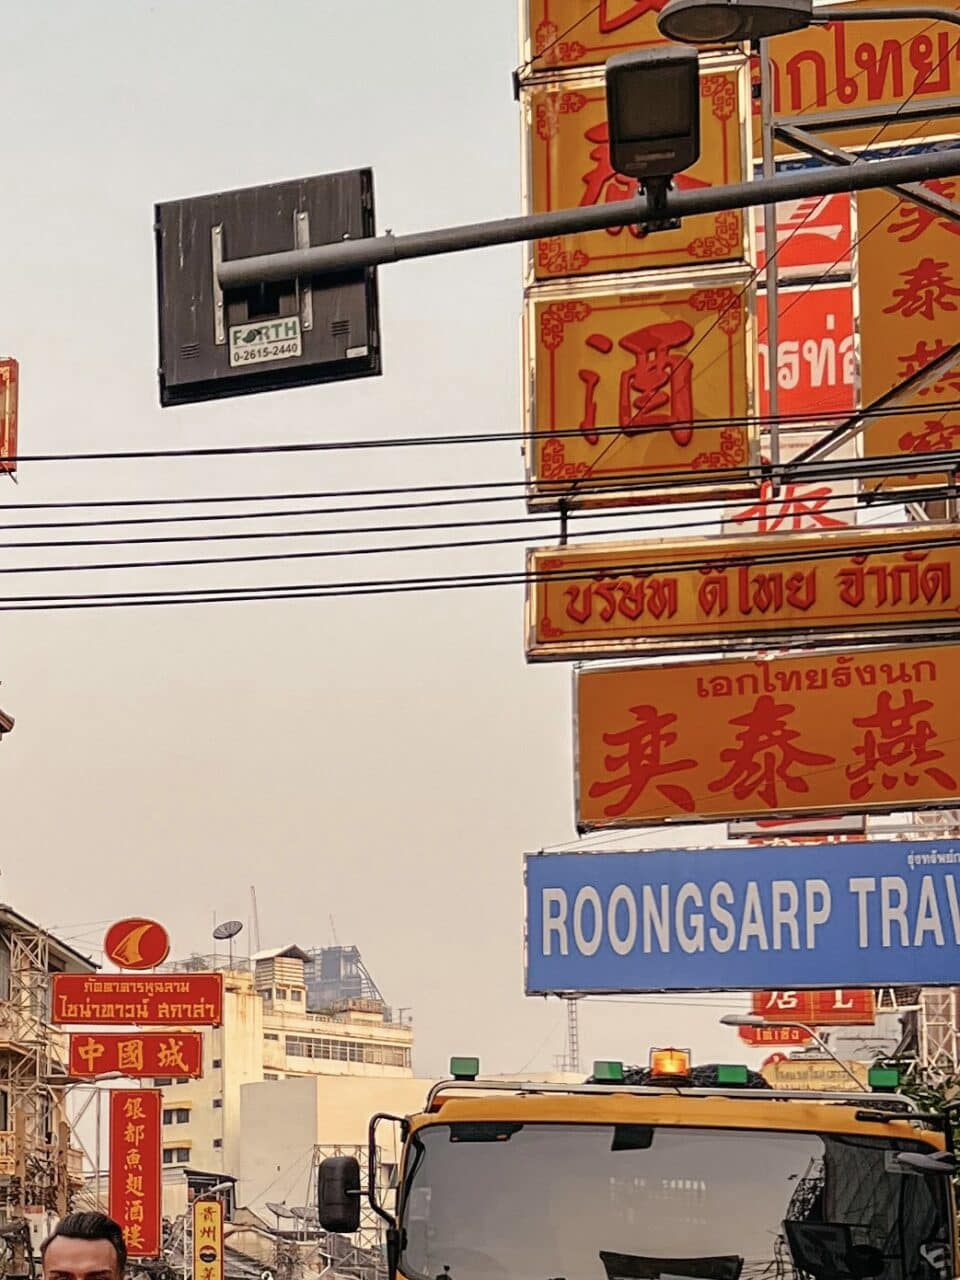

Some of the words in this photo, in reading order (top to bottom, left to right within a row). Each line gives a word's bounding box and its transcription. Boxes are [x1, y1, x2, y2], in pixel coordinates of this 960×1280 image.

[233, 343, 298, 362] 0-2615-2440
[578, 320, 694, 447] 酒
[542, 878, 831, 957] ROONGSARP
[59, 995, 149, 1019] ไชน่าทาวน์
[157, 997, 215, 1019] สกาล่า
[78, 1037, 189, 1072] 中國城
